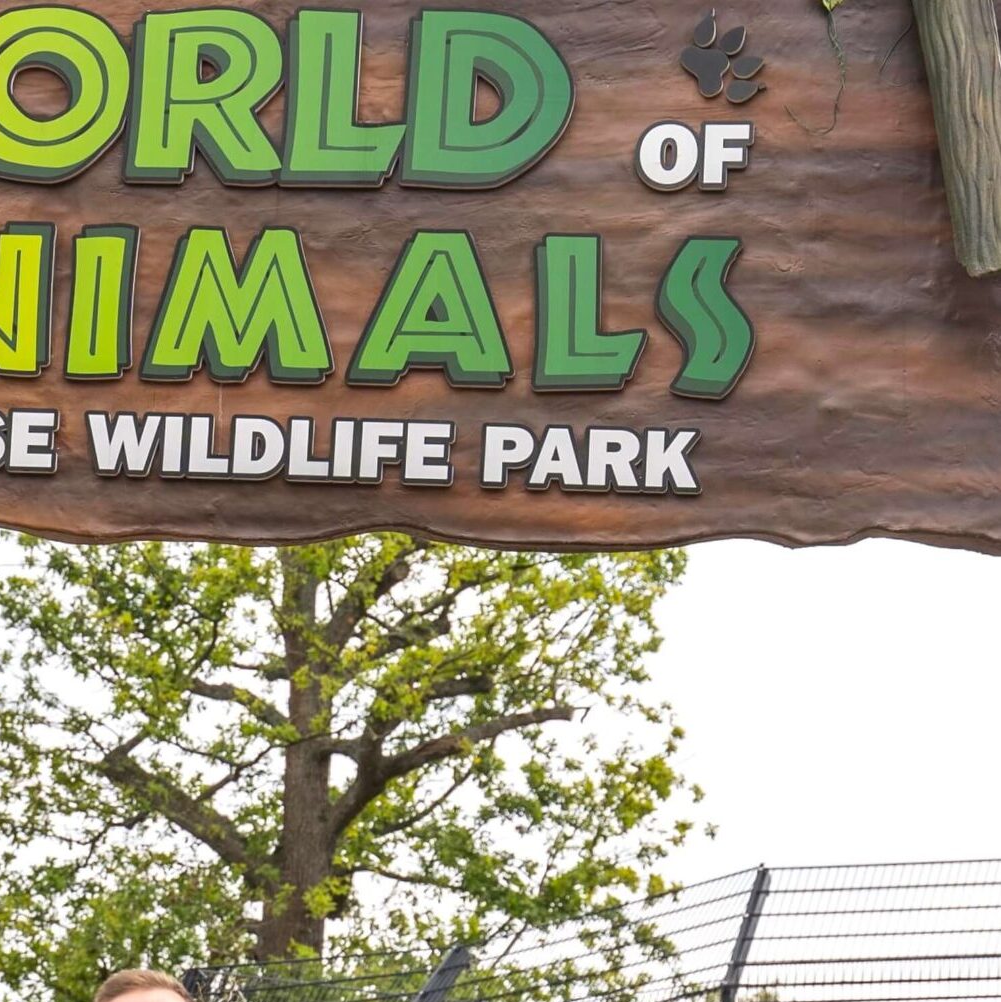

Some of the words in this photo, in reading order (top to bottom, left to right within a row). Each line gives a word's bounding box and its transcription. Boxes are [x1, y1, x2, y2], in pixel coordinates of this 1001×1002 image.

[636, 120, 754, 191] OF
[87, 411, 455, 487] WILDLIFE
[480, 423, 702, 494] PARK
